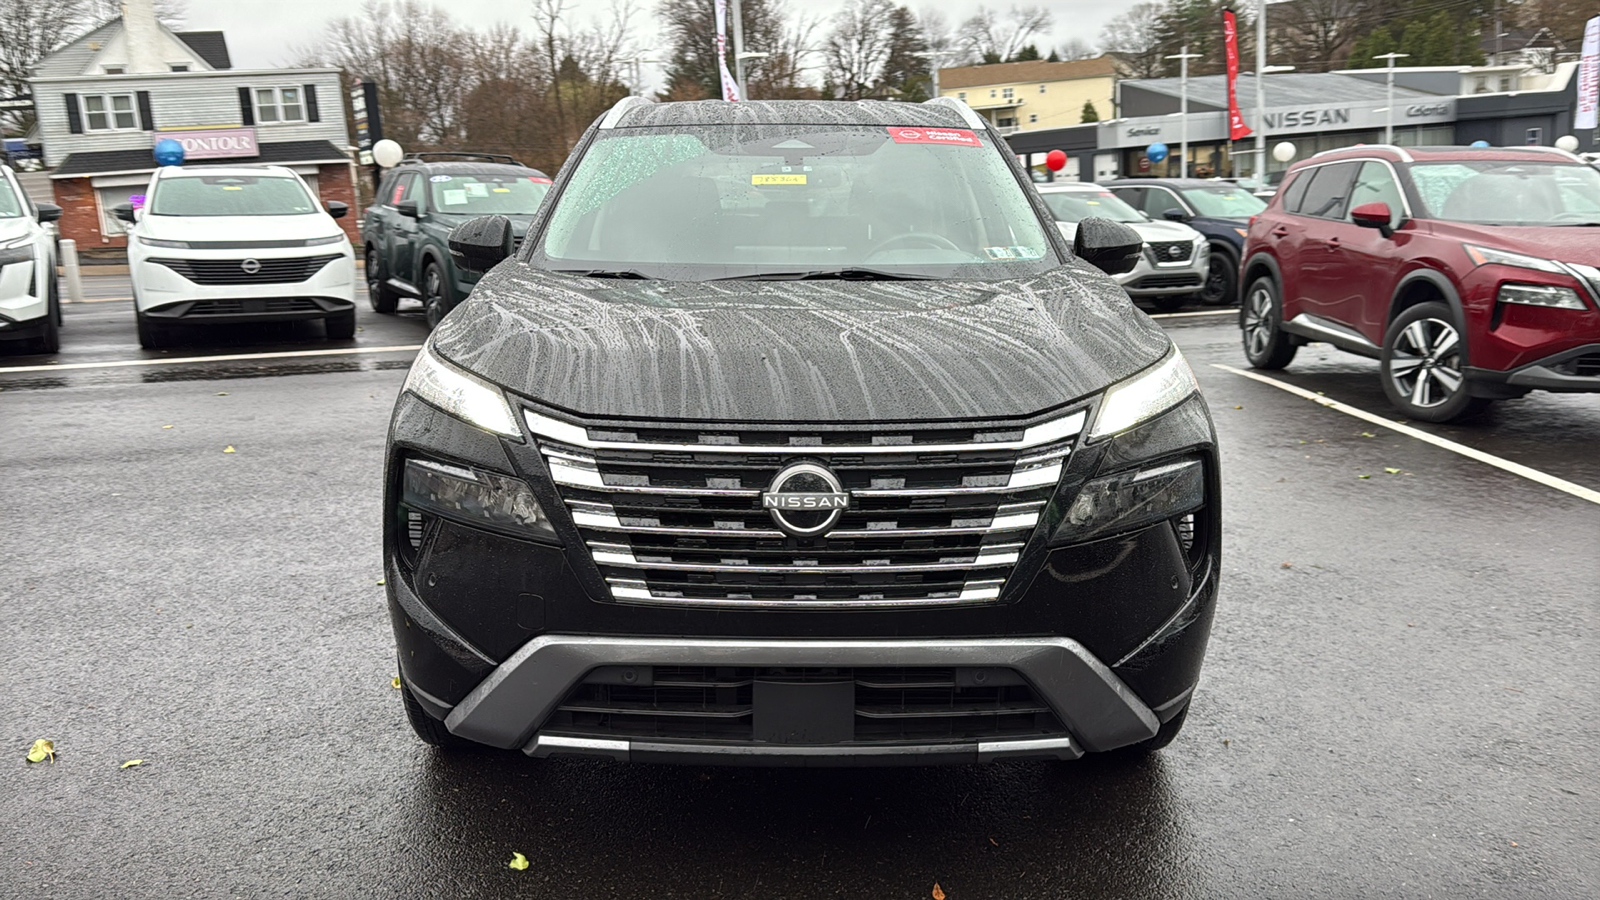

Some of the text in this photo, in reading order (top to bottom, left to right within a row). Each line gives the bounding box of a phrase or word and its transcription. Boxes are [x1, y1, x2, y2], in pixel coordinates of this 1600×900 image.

[1263, 108, 1350, 129] NISSAN
[174, 136, 252, 152] ONTOUR
[928, 135, 973, 143] Certified
[765, 496, 847, 507] NISSAN
